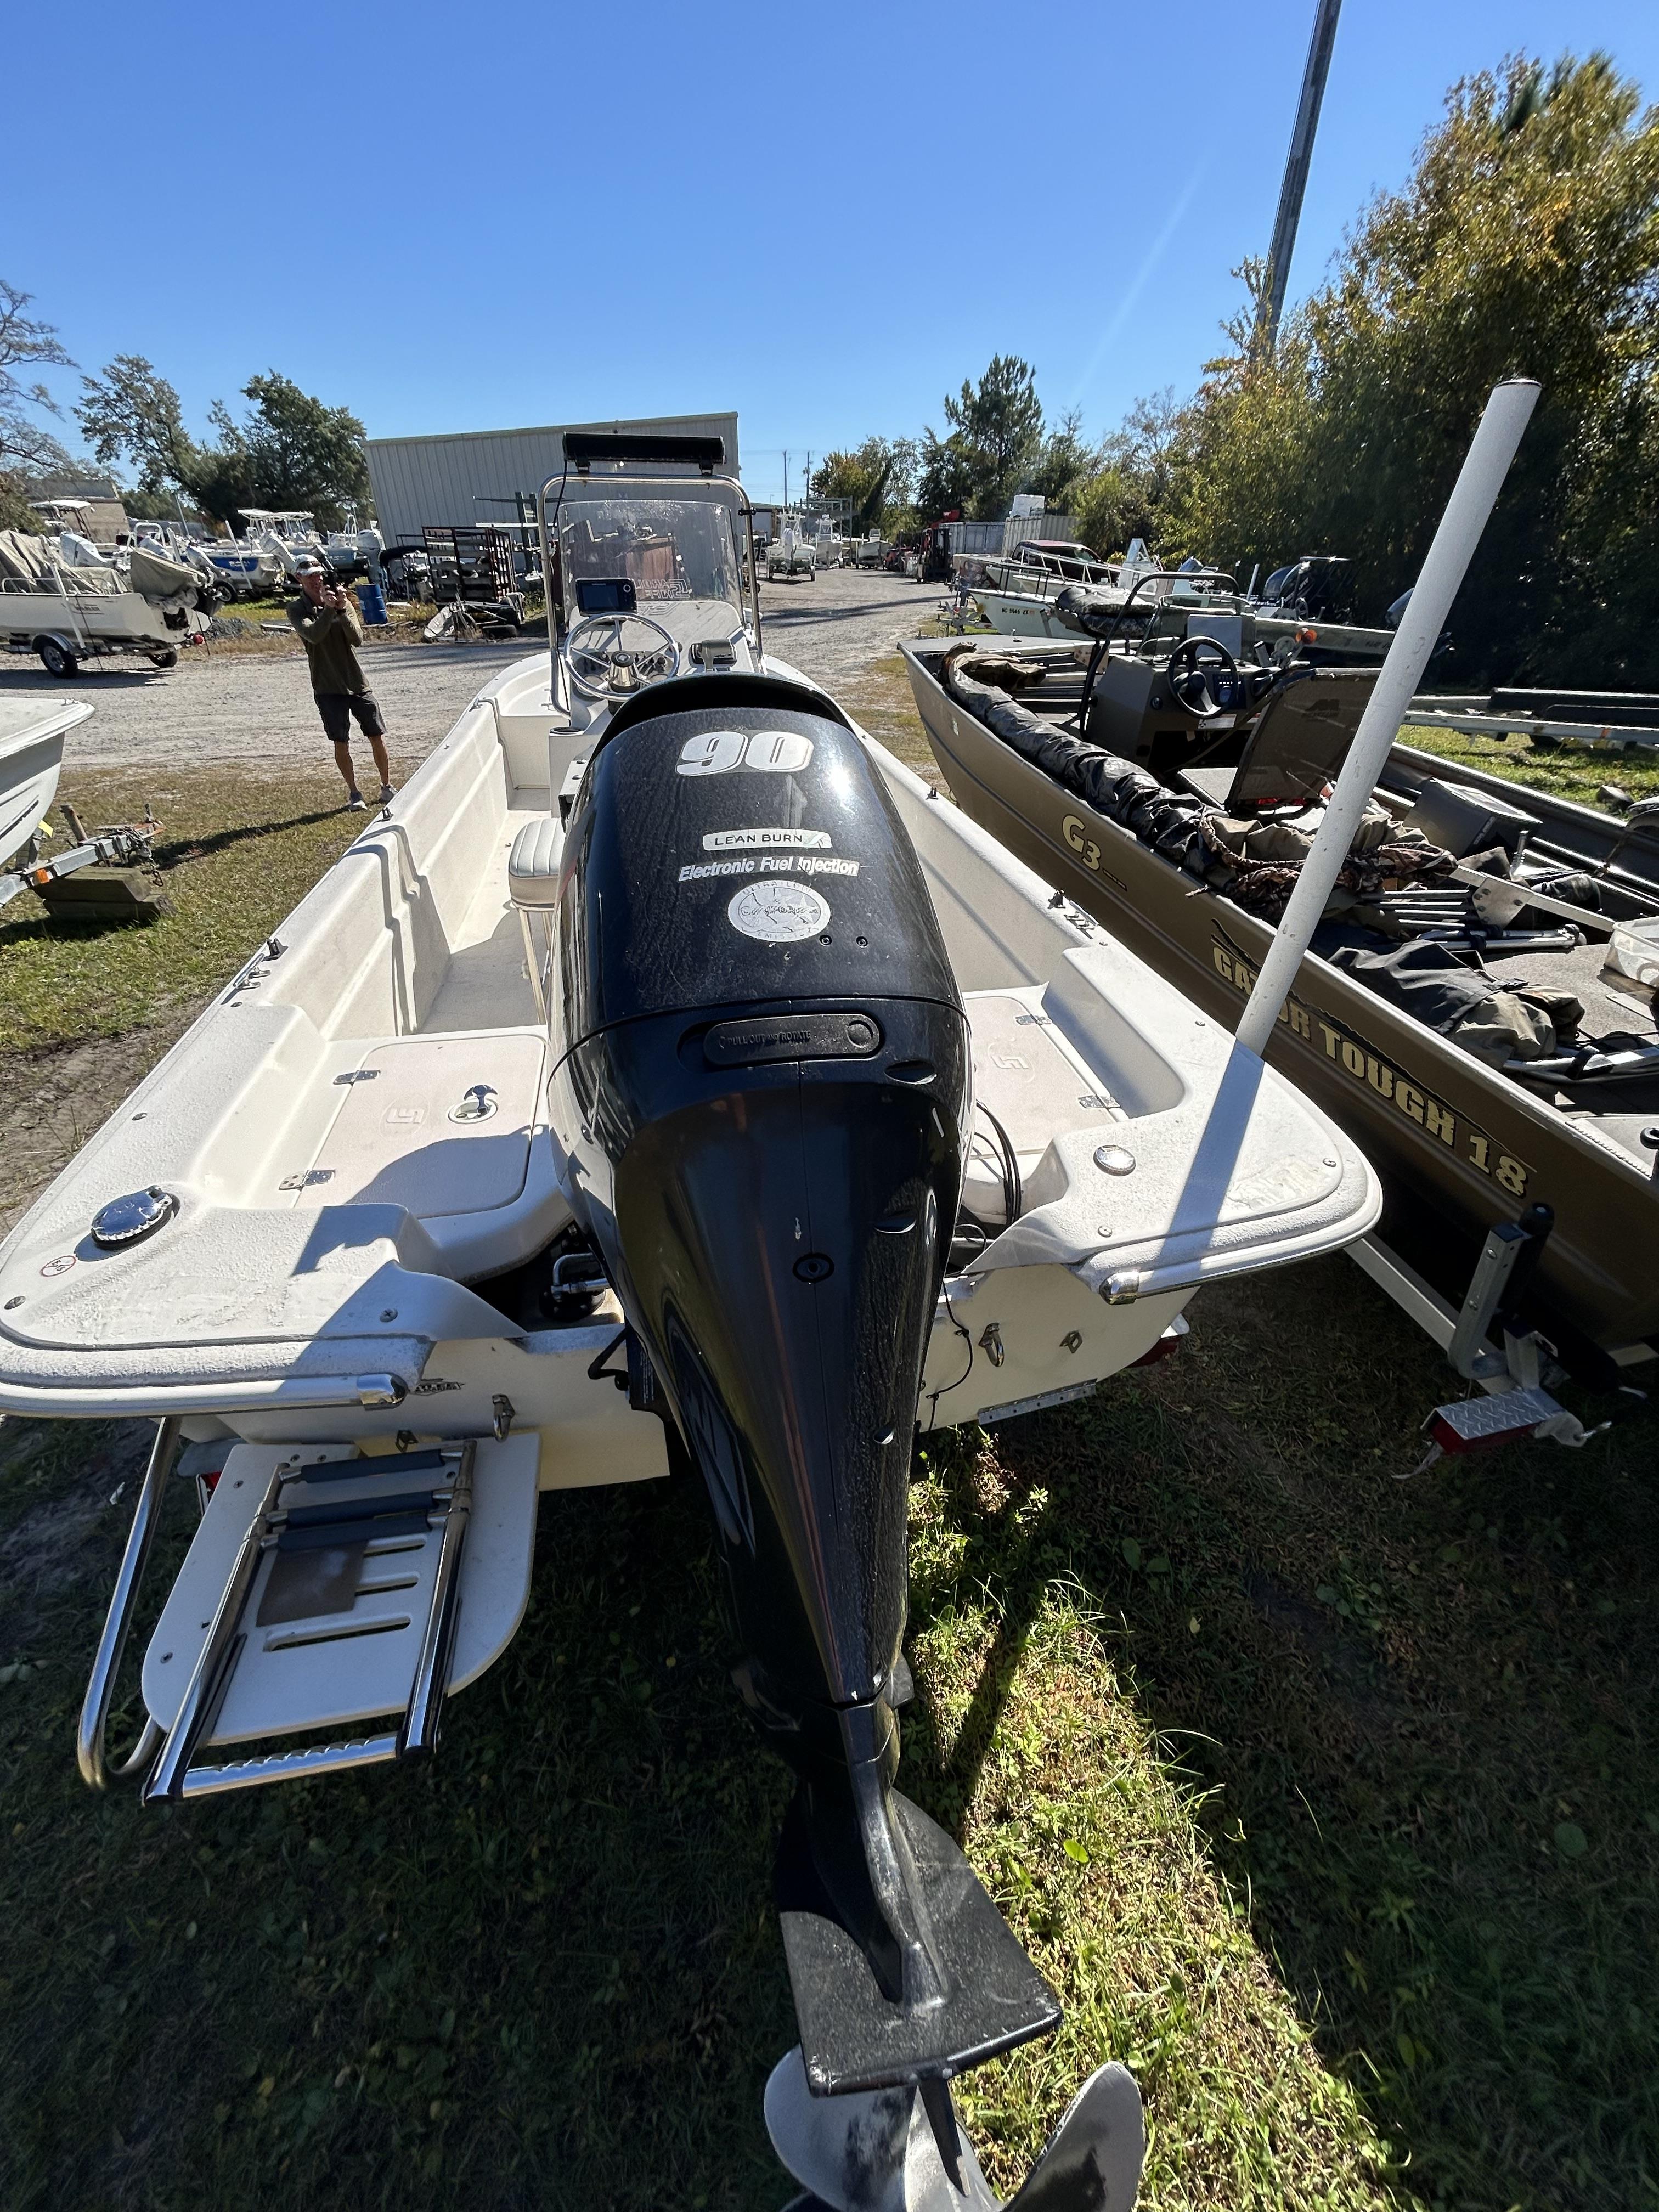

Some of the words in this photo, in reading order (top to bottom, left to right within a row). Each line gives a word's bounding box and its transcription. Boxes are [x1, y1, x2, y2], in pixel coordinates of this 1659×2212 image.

[675, 731, 814, 776] 90
[715, 834, 756, 845] LEAN
[761, 834, 802, 843] BURN
[1062, 815, 1102, 871] G3
[678, 858, 755, 882] Electronic
[760, 856, 794, 871] Fuel
[797, 857, 860, 877] Injection
[727, 1035, 748, 1046] PULL
[750, 1034, 765, 1043] OUT
[780, 1030, 811, 1041] ROTATE
[1213, 947, 1312, 1043] GAR
[1318, 1022, 1456, 1148] TOUGH
[1469, 1135, 1528, 1197] 18
